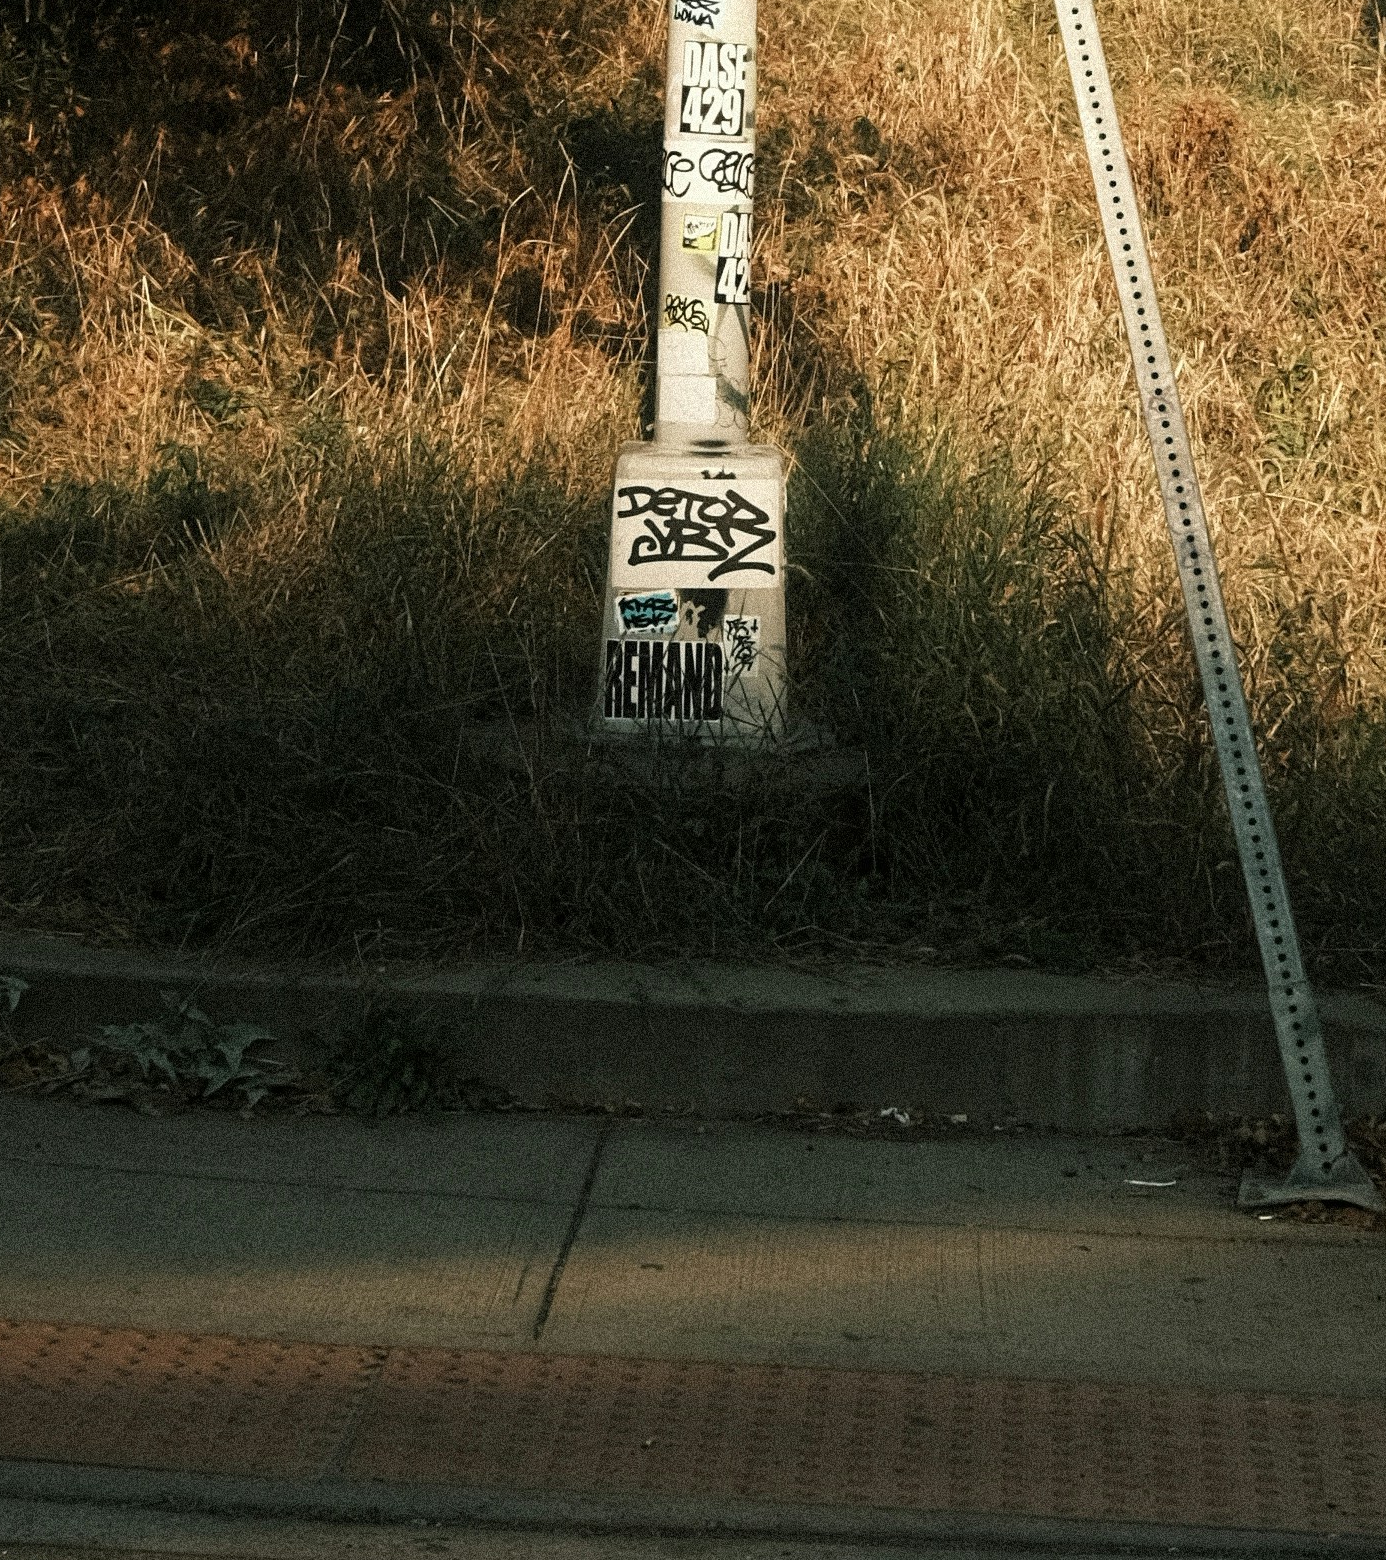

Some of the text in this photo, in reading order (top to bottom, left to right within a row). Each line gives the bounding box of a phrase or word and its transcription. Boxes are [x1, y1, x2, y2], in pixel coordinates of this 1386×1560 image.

[683, 41, 748, 89] DASE
[682, 87, 742, 135] 429
[604, 639, 723, 721] REMAND
